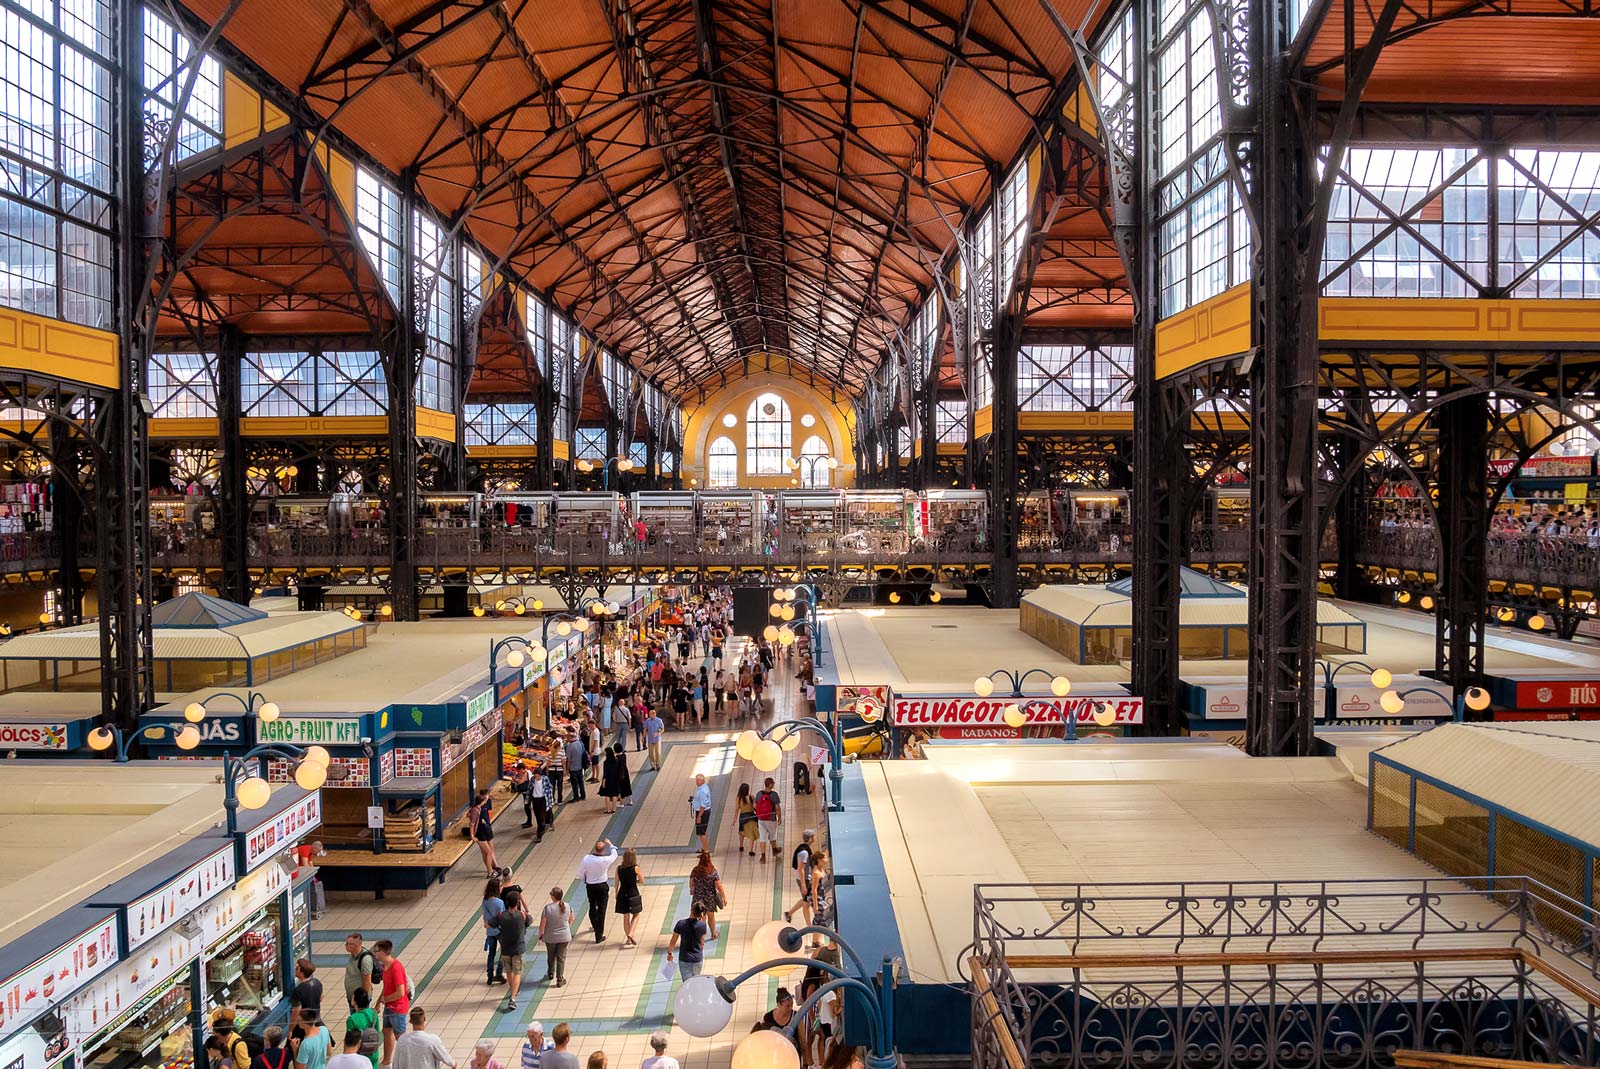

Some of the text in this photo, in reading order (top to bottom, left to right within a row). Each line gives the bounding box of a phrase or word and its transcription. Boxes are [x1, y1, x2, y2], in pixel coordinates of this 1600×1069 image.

[1569, 683, 1597, 704] HÚS
[260, 720, 333, 741] AGRO-FRUIT
[961, 728, 1018, 738] KABANOS
